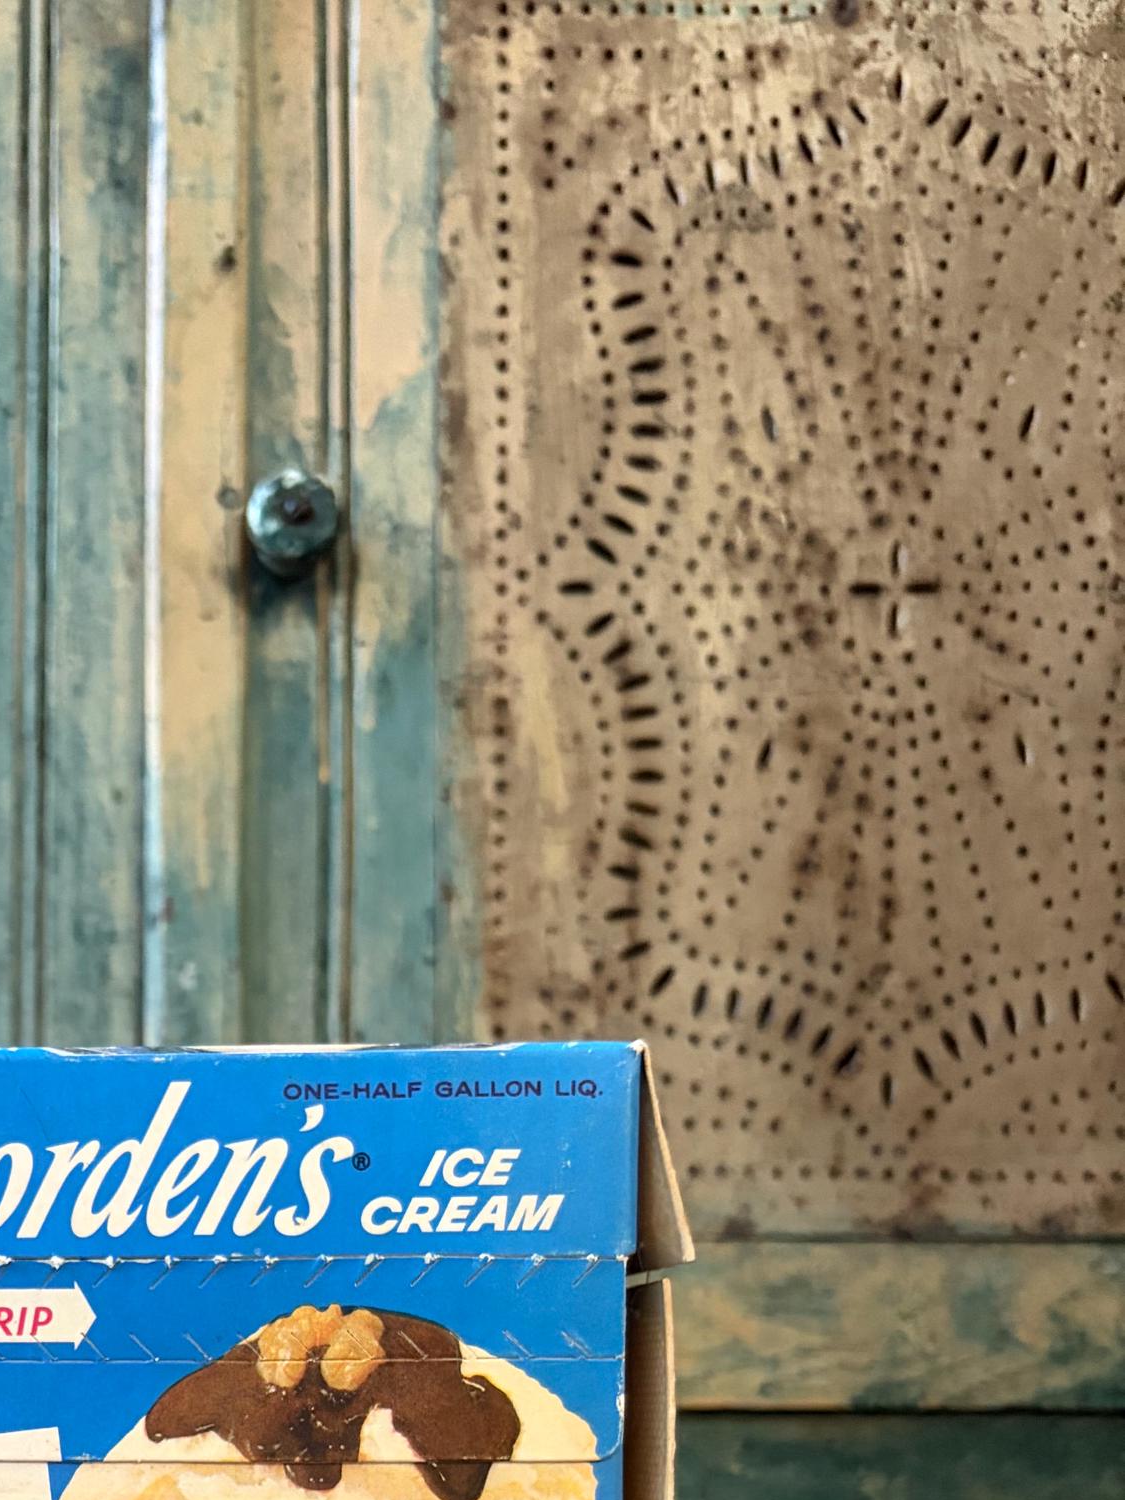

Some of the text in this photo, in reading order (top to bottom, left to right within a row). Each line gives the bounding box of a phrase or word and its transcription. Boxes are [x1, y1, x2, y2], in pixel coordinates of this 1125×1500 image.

[282, 1078, 605, 1101] ONE-HALF GALLON LIQ.
[419, 1148, 522, 1188] ICE
[360, 1194, 565, 1234] CREAM
